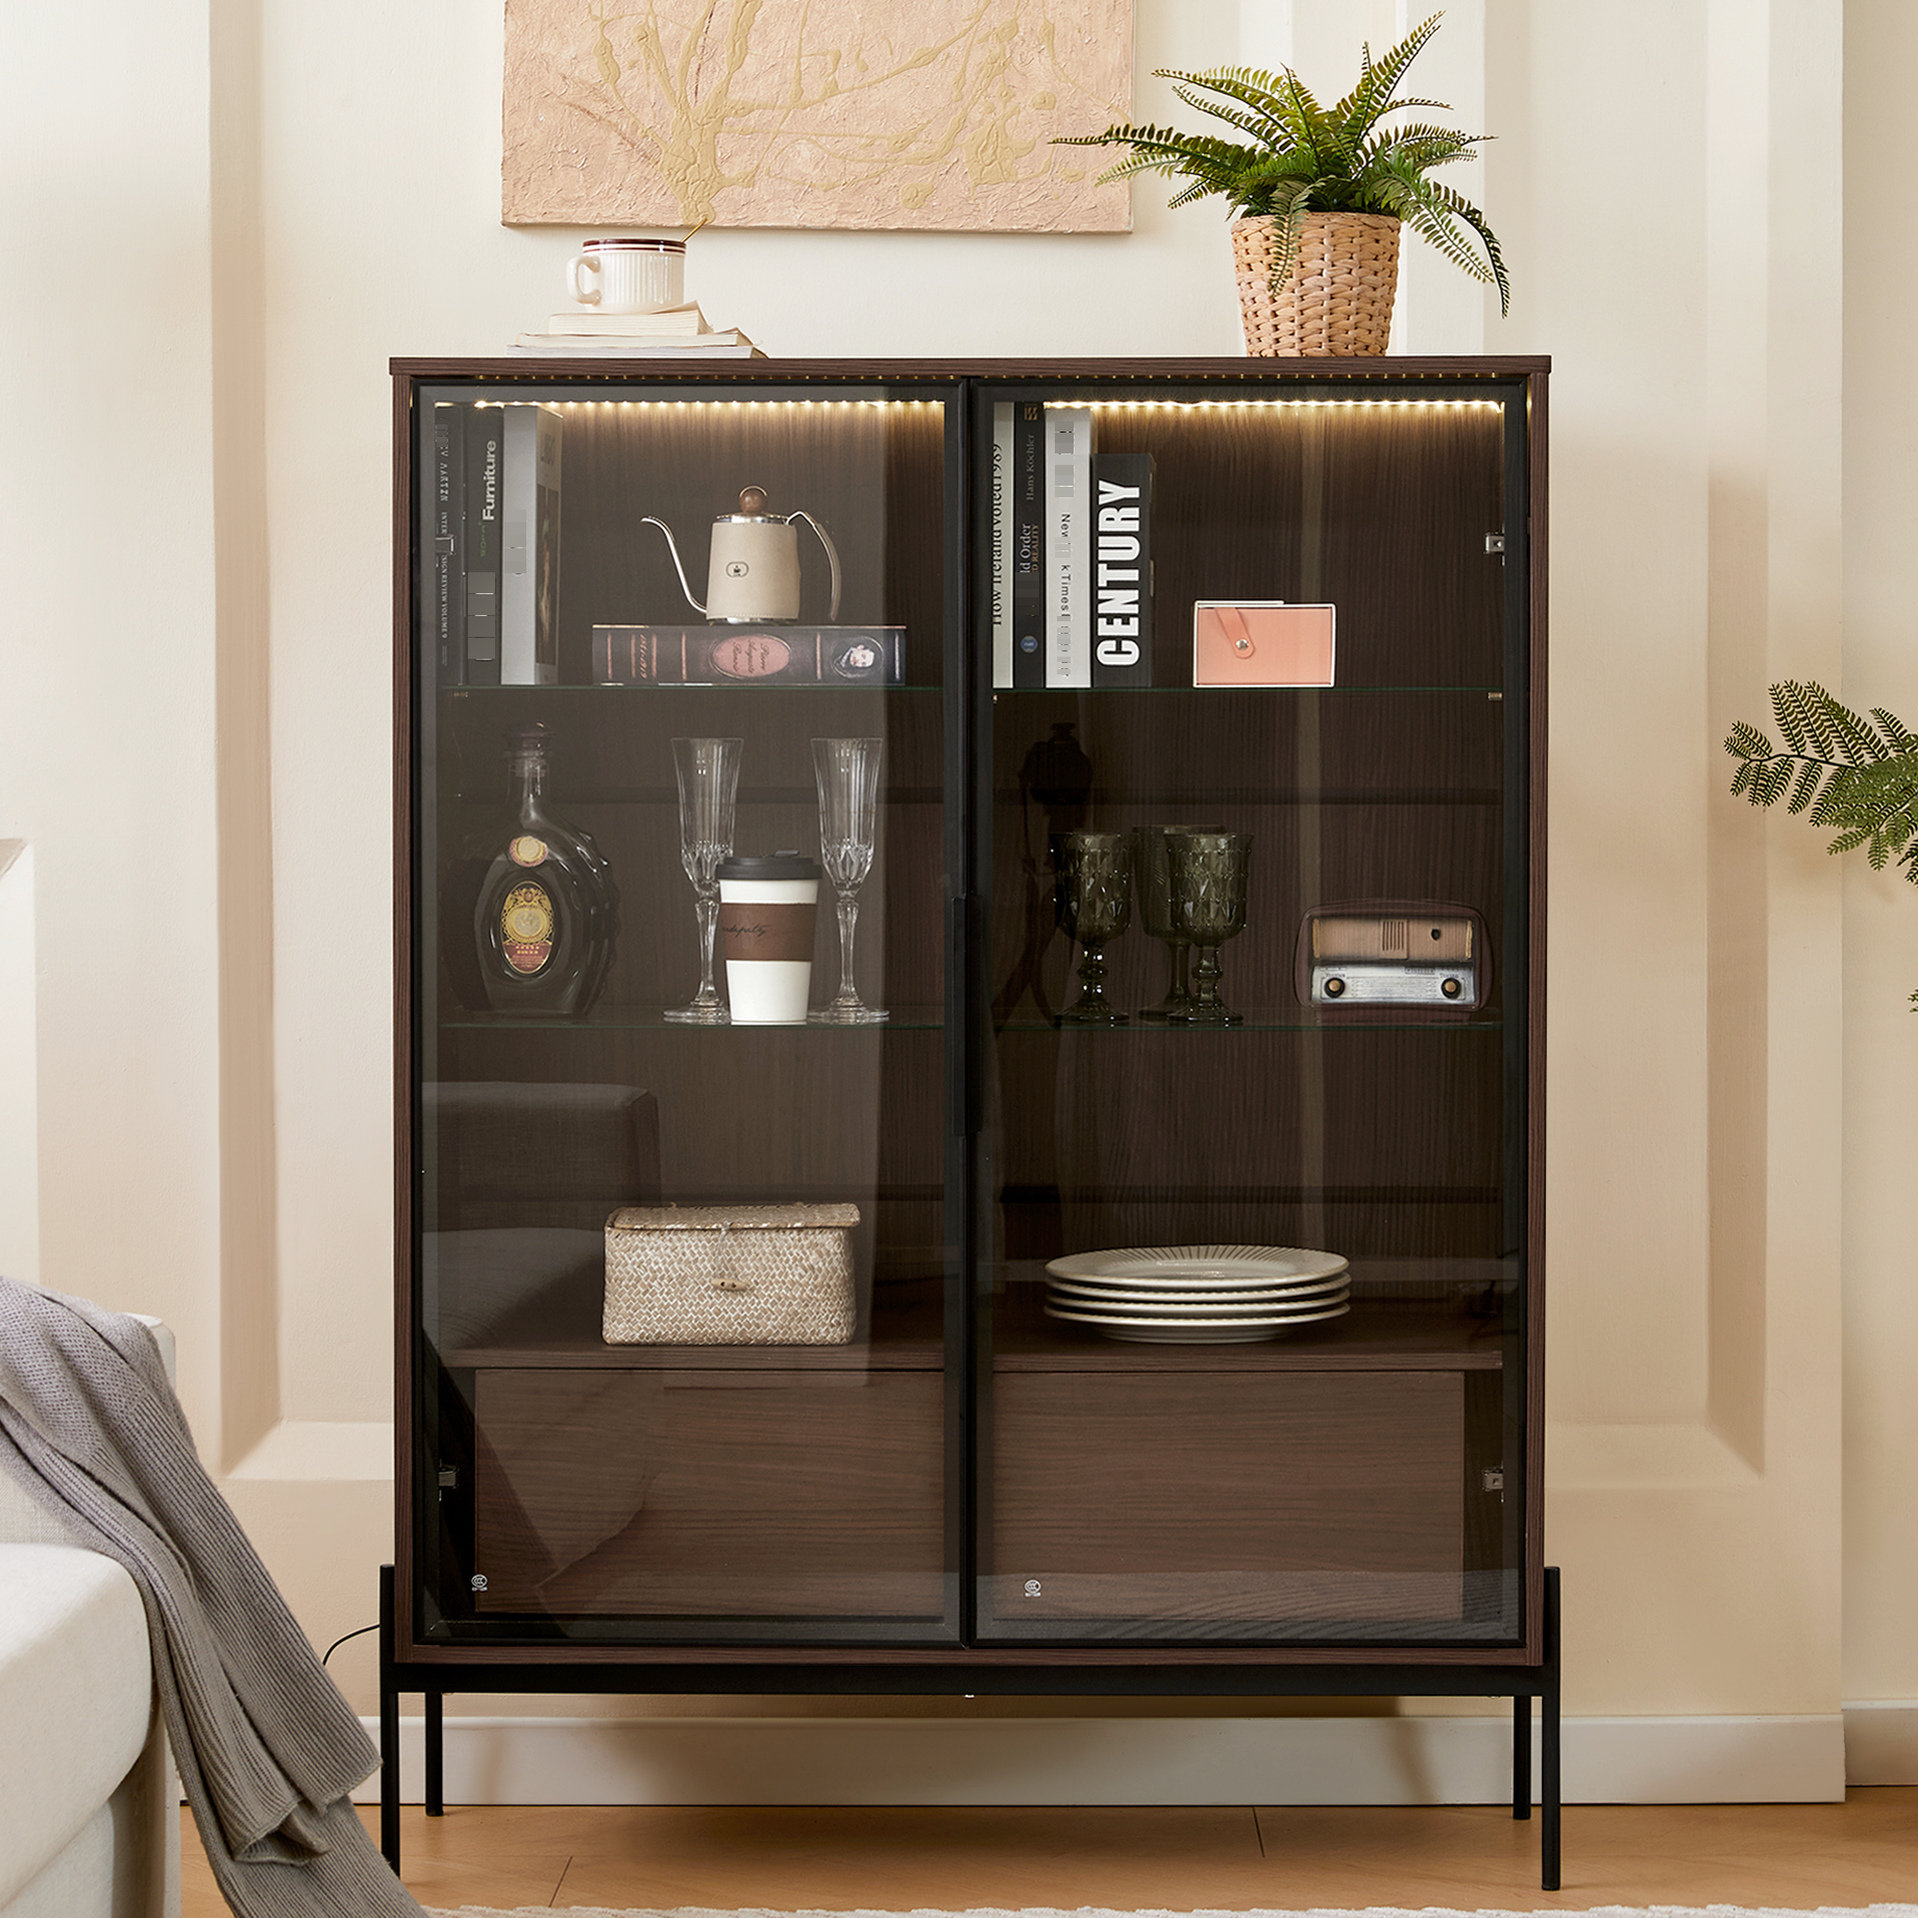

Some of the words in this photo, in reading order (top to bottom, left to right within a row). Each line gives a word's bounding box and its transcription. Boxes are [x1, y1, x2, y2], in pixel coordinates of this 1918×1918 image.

[481, 440, 497, 521] Furniture
[1026, 475, 1035, 501] Hans
[1019, 523, 1031, 559] Order
[1061, 573, 1070, 611] Times
[1096, 480, 1142, 667] CENTURY
